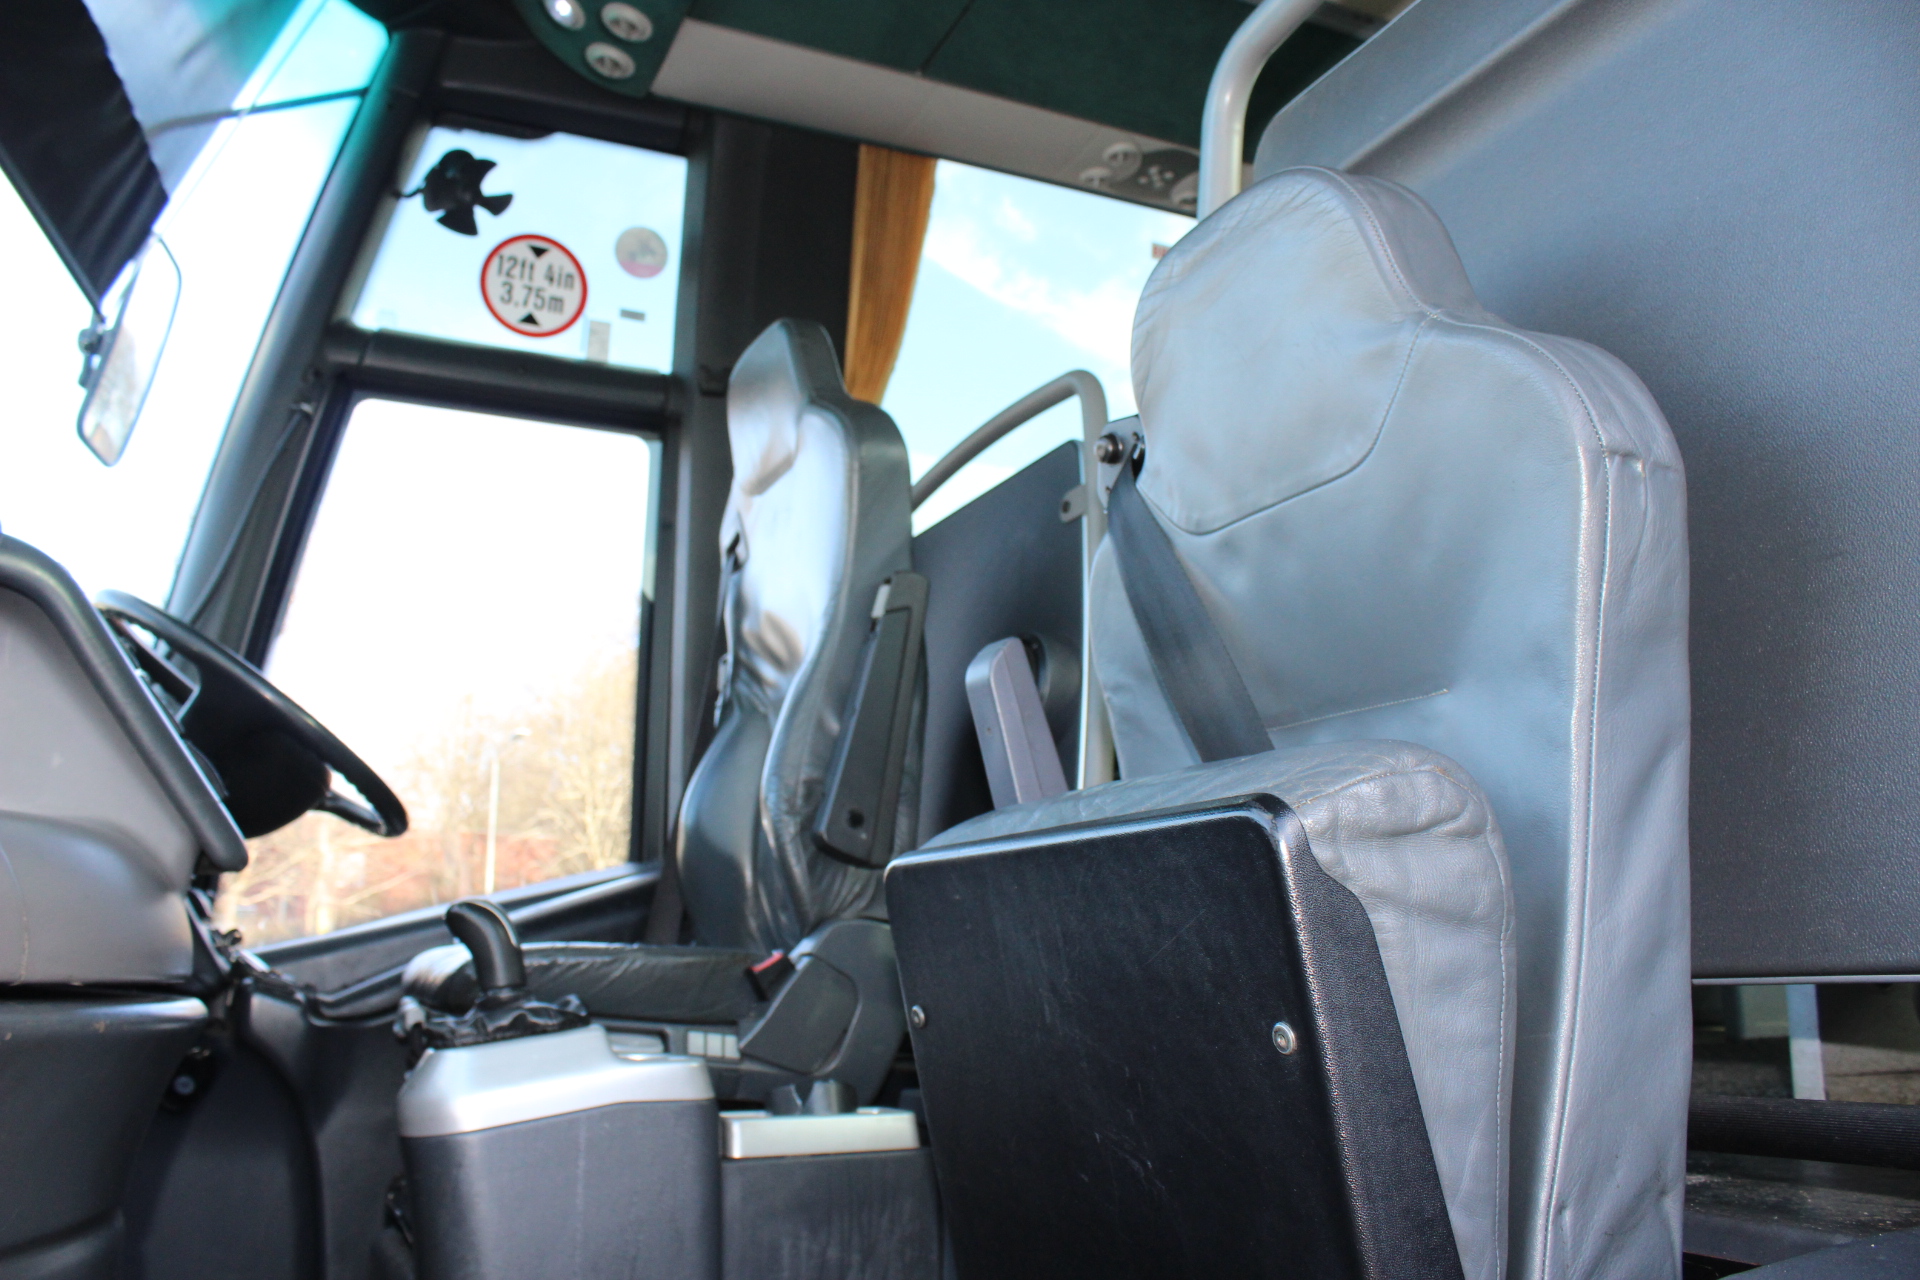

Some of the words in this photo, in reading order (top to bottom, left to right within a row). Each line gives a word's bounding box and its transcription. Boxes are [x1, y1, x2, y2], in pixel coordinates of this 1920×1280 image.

[497, 254, 534, 282] 12ft
[544, 263, 575, 290] 4in
[500, 281, 564, 314] 3.75m
